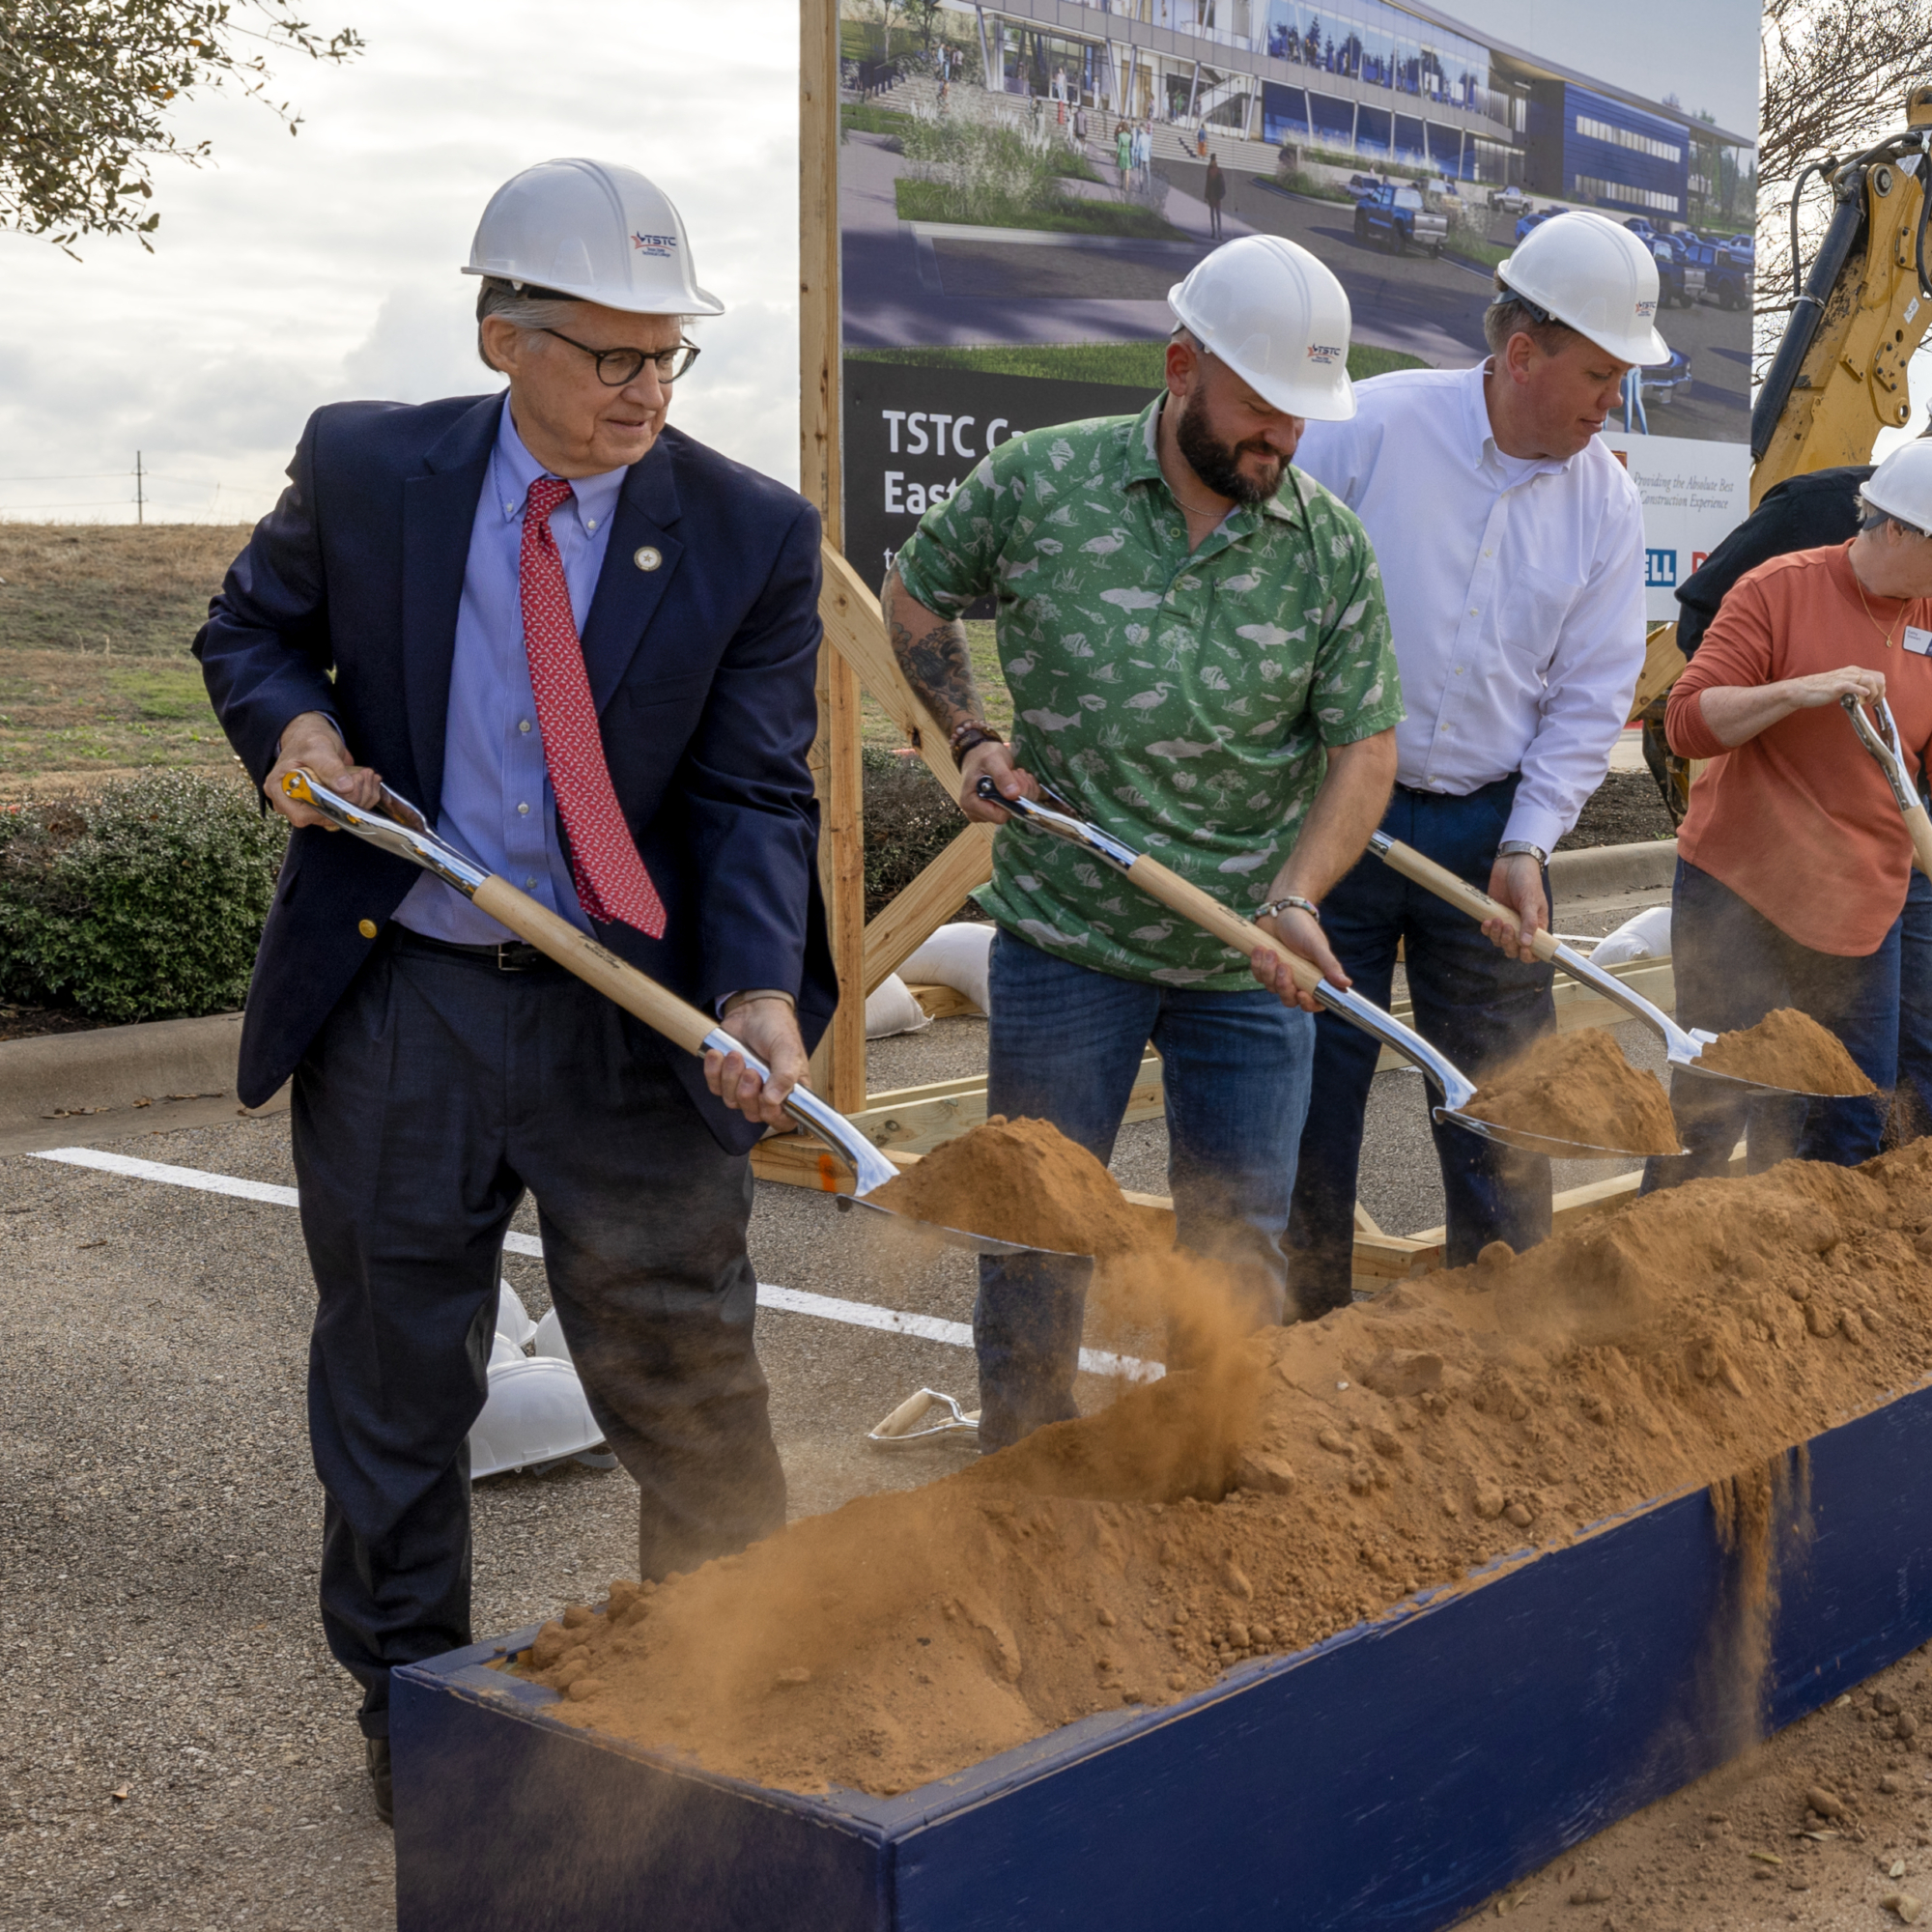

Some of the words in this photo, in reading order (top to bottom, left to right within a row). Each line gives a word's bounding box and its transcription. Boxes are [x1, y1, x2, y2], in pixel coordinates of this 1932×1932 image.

[644, 235, 676, 246] TSTC
[1318, 345, 1341, 356] TSTC
[882, 410, 976, 458] TSTC
[985, 418, 1024, 452] C
[1634, 471, 1671, 493] Providing
[1673, 474, 1686, 489] the
[1686, 475, 1718, 492] Absolute
[1719, 478, 1734, 493] Best
[1639, 490, 1688, 507] Construction
[1690, 493, 1729, 513] Experience
